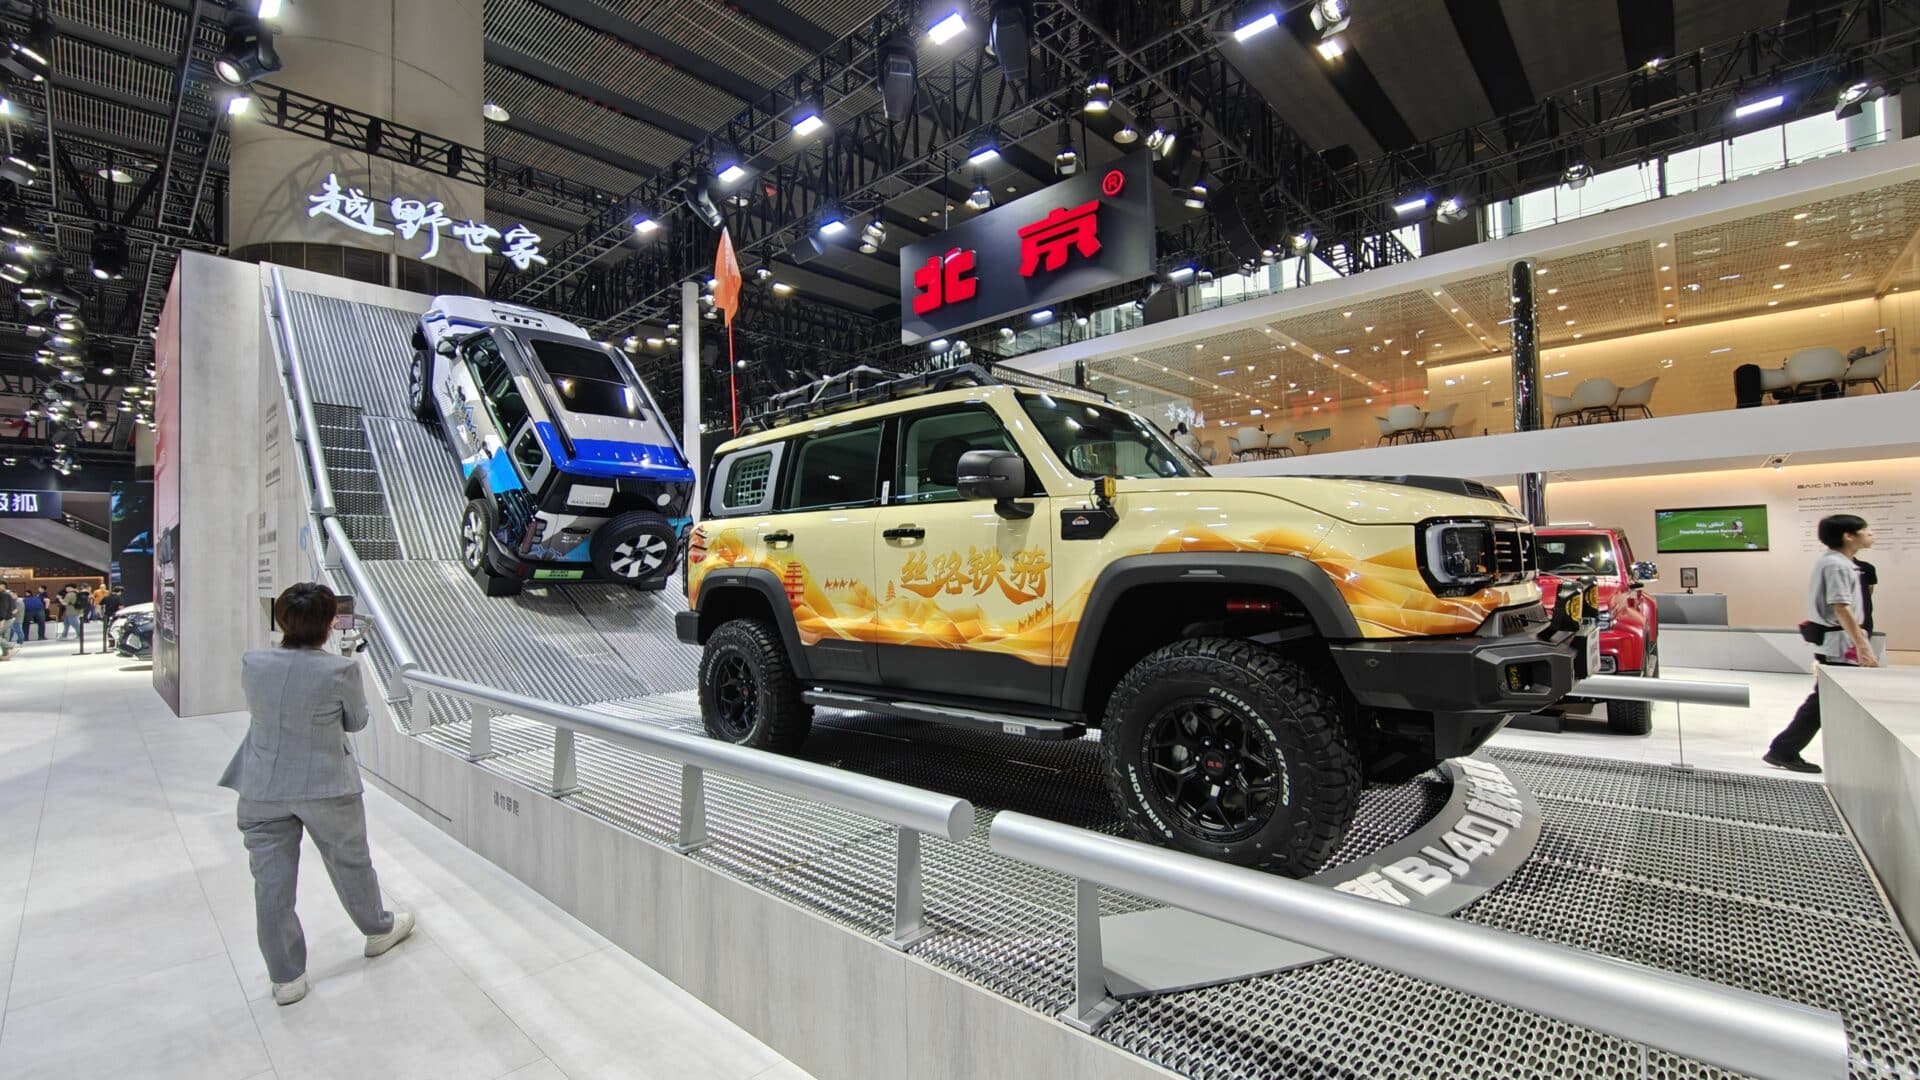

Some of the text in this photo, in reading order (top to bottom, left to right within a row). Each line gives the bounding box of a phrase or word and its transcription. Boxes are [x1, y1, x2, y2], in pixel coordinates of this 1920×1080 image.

[308, 173, 549, 270] 越野世家
[913, 199, 1102, 315] 北京
[900, 544, 1051, 605] 丝路铁骑
[1208, 687, 1277, 742] FIGHTER
[1128, 763, 1166, 831] NINEVONT
